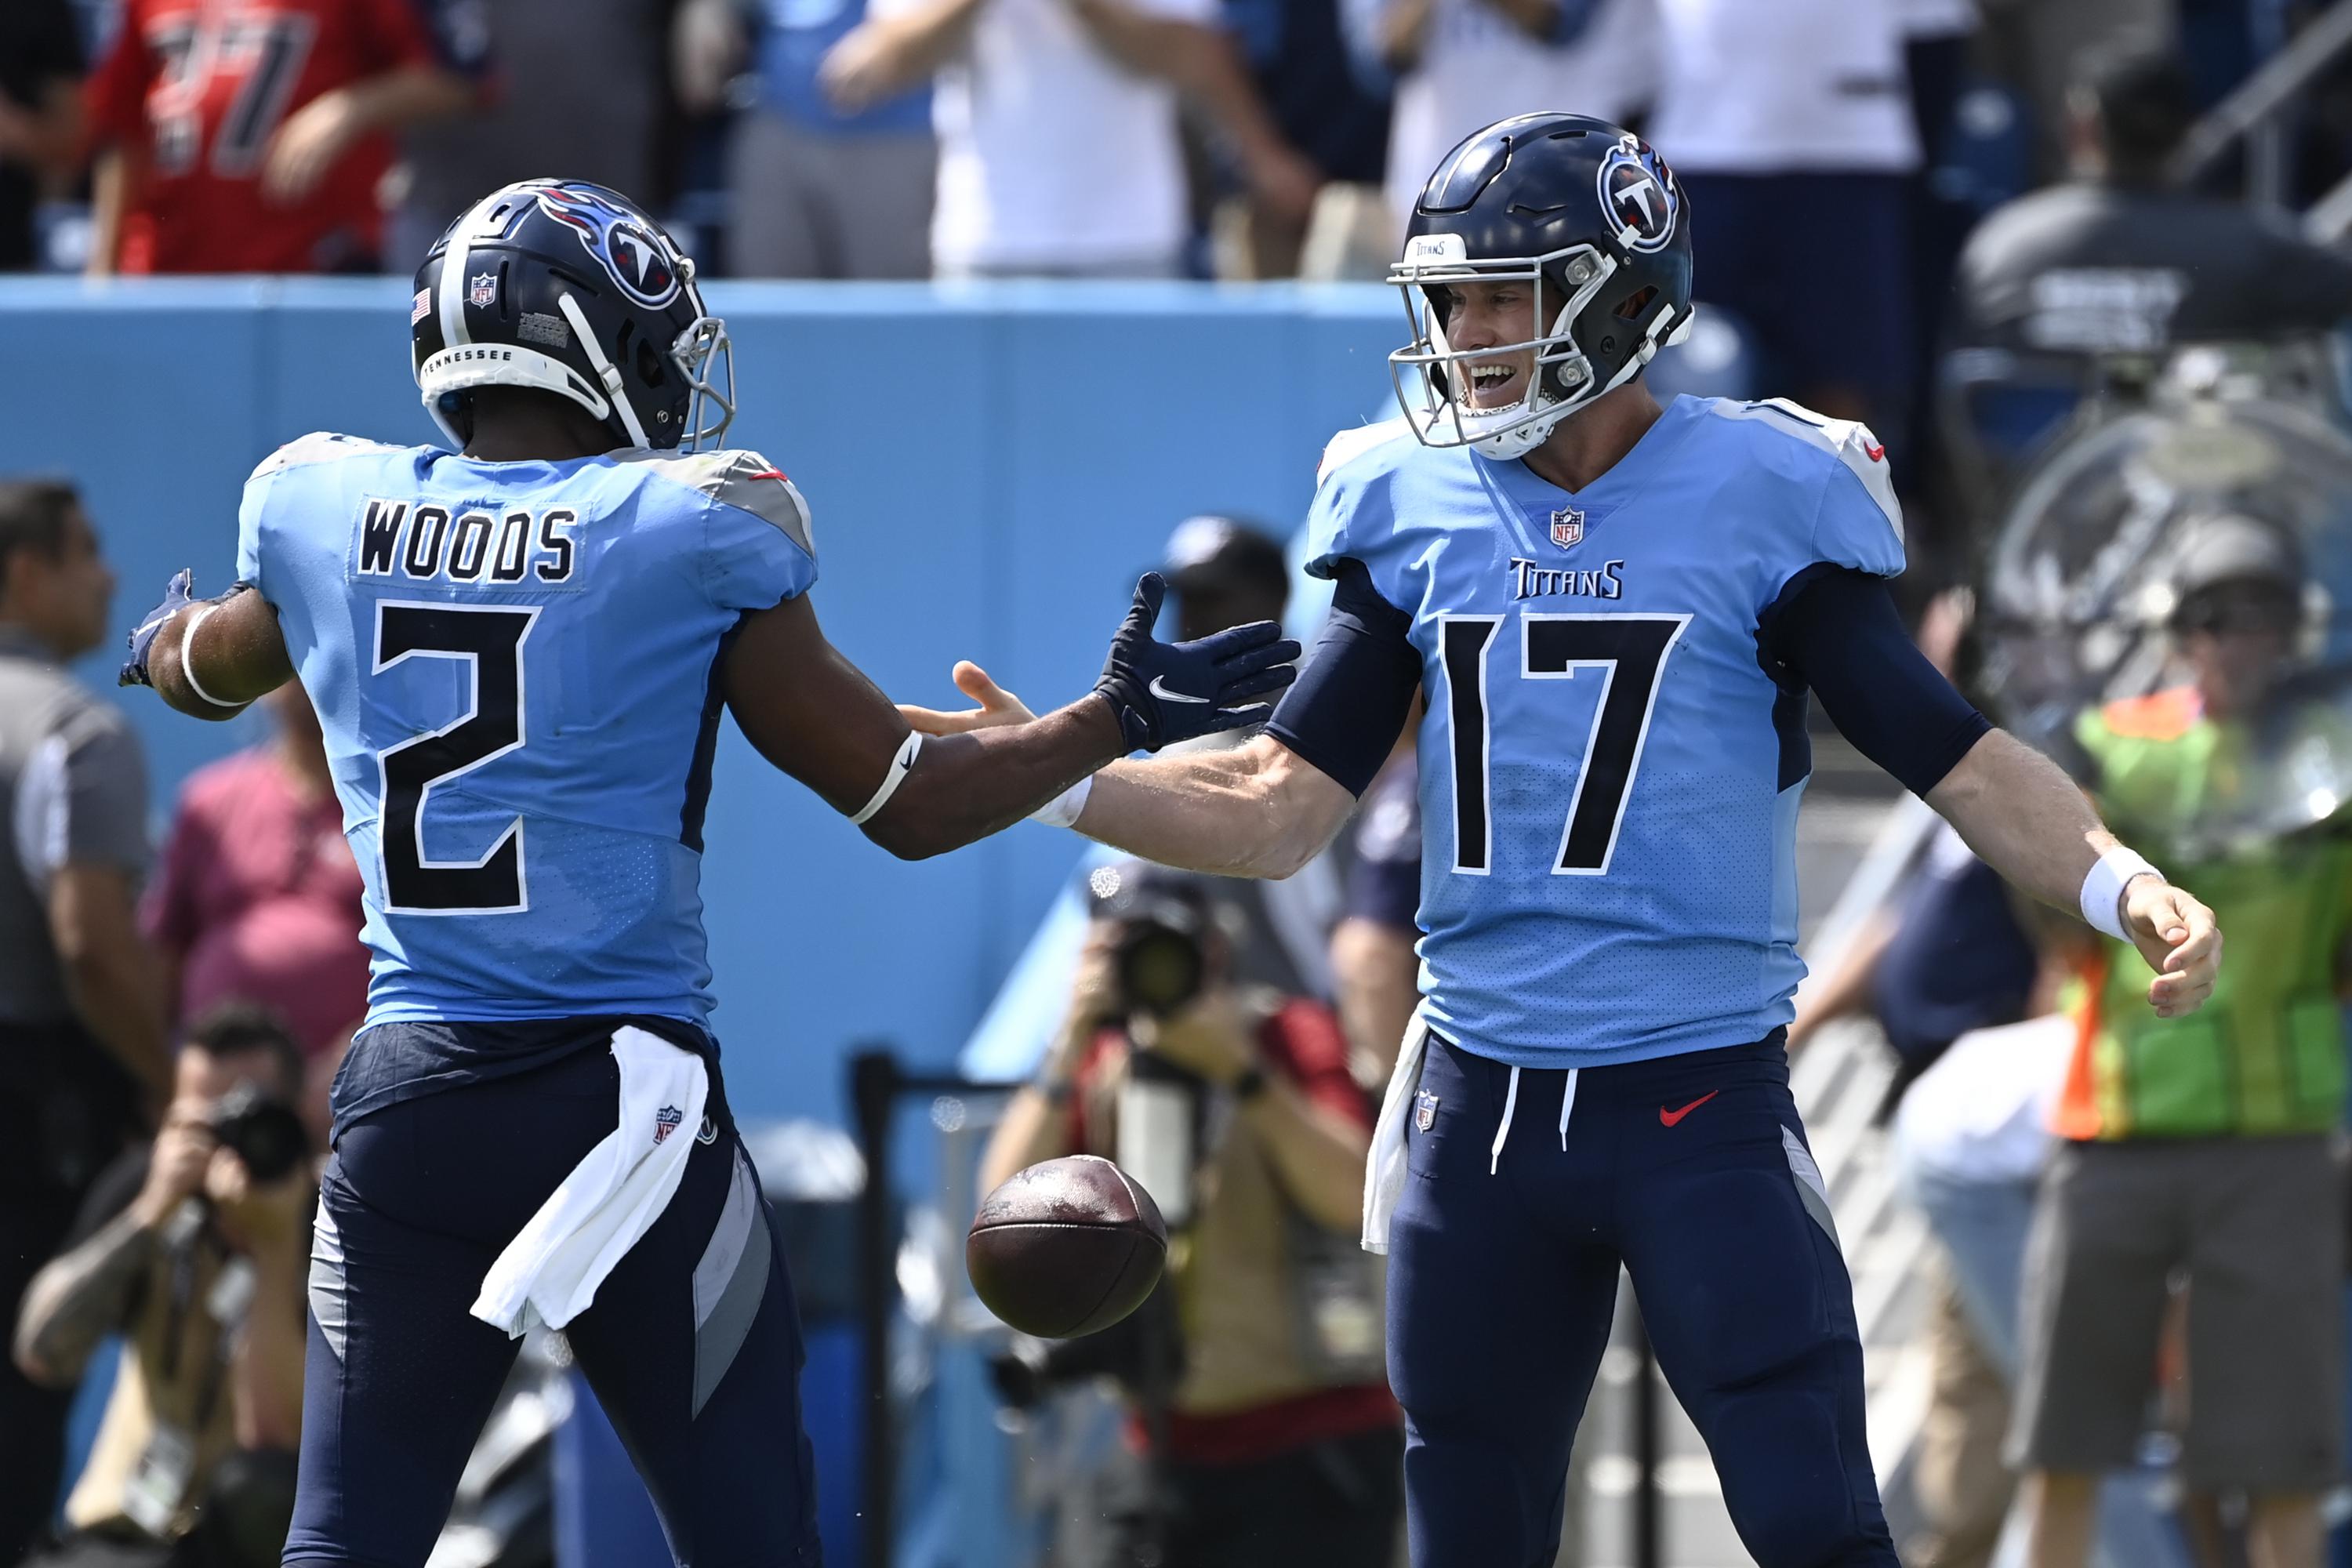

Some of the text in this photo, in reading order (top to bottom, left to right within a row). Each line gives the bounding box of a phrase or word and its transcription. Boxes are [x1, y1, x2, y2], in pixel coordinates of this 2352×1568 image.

[1416, 240, 1446, 256] TITANS
[474, 288, 492, 303] NFL
[424, 350, 512, 377] TENNESSEE
[357, 496, 579, 584] WOODS
[1555, 524, 1579, 542] NFL
[1510, 557, 1624, 601] TITANS
[372, 598, 543, 916] 2
[1438, 613, 1694, 876] 17
